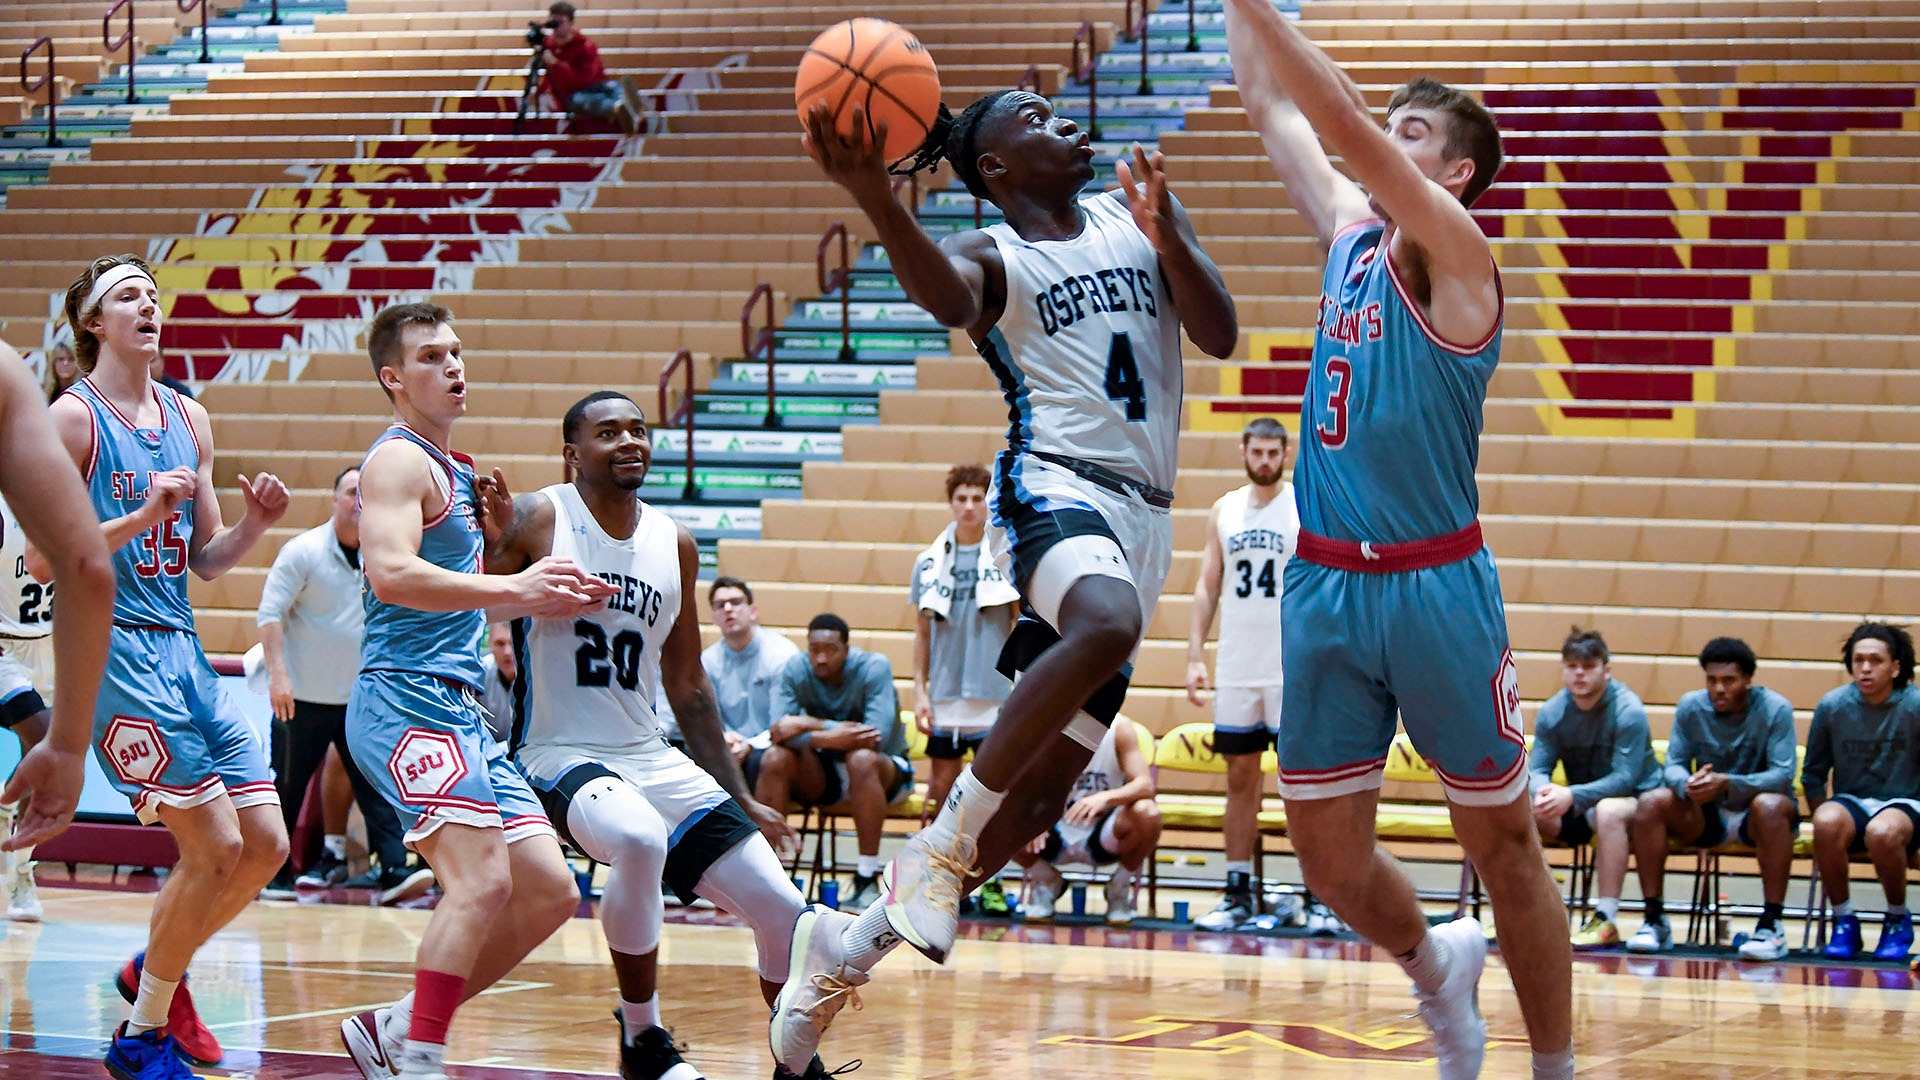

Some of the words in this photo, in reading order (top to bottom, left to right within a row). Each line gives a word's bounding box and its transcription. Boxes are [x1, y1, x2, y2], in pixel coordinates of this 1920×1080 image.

[1036, 267, 1157, 337] OSPREYS
[1103, 331, 1147, 422] 4
[1316, 356, 1352, 450] 3
[135, 510, 188, 578] 35
[1236, 558, 1276, 598] 34
[574, 617, 644, 692] 20
[119, 740, 150, 767] SJU
[405, 751, 444, 782] SJU
